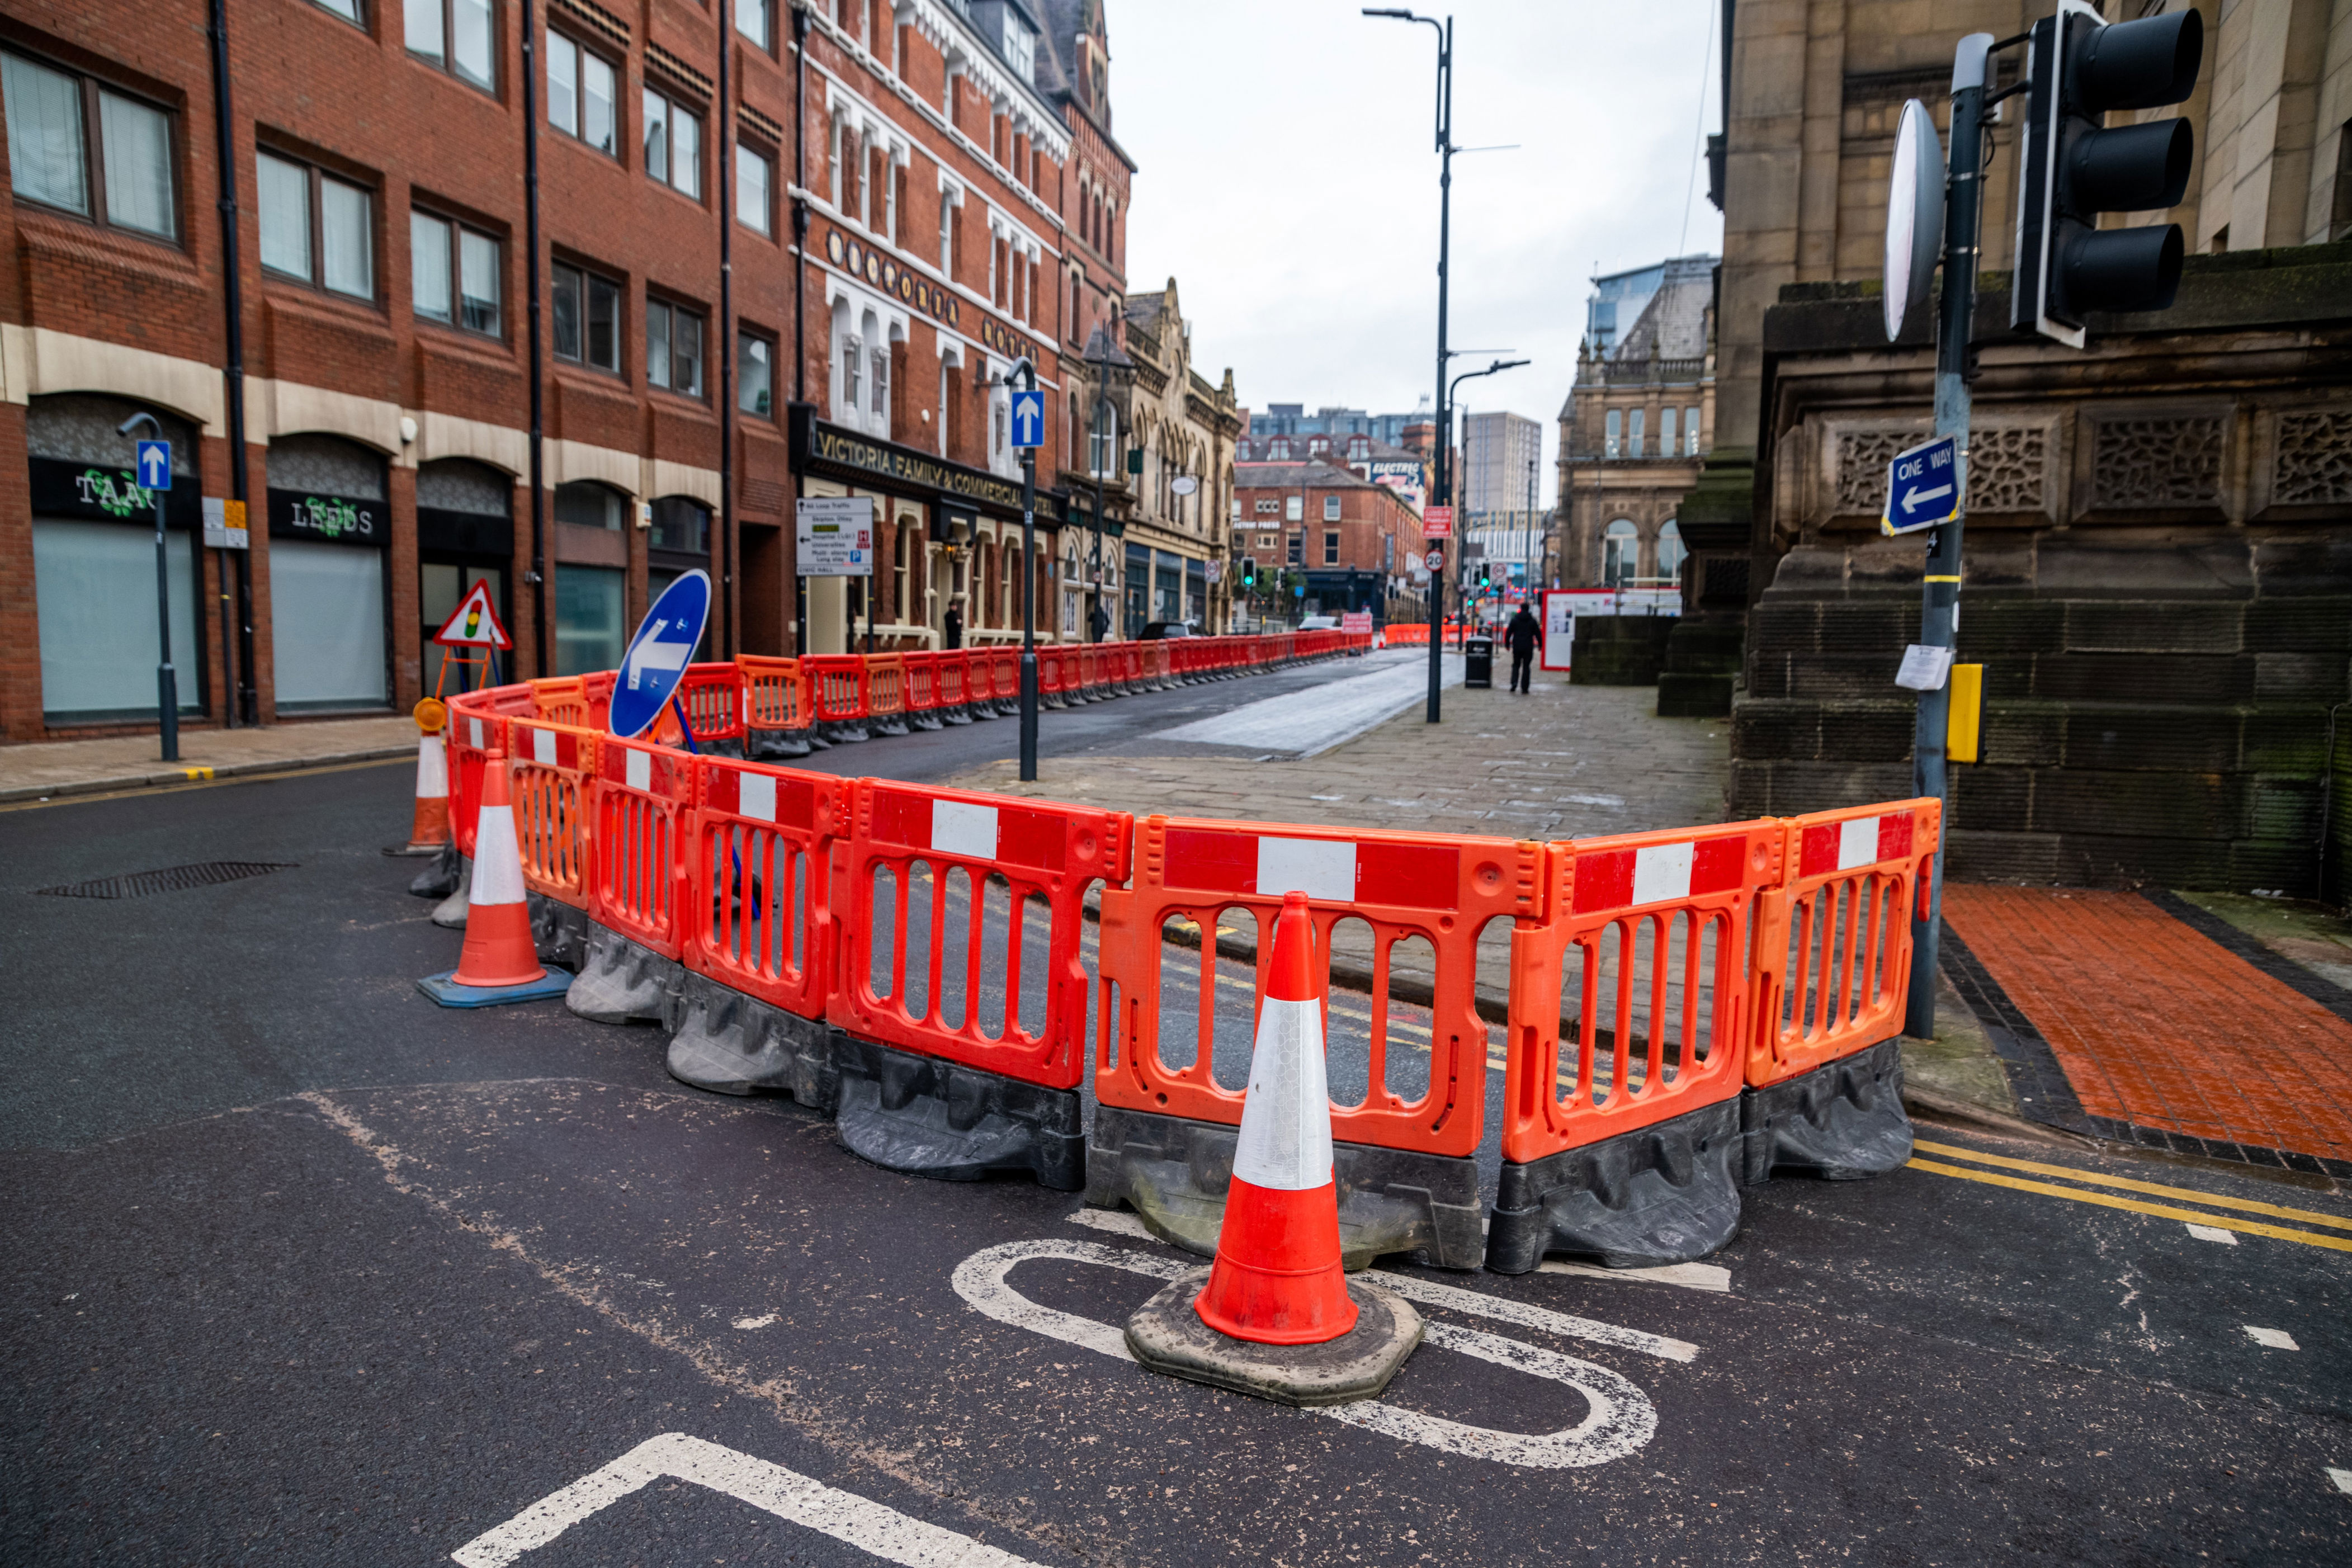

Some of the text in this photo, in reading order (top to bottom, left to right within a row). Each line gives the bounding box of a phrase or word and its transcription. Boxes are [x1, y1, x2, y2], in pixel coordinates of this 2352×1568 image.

[832, 232, 957, 323] VICTORIA
[818, 431, 1057, 518] VICTORIA FAMILY & COMMERCIAL OTEL
[1372, 462, 1420, 474] ELECTRIC
[1898, 446, 1952, 480] ONE WAY
[75, 475, 157, 510] TAA
[291, 503, 373, 535] LEEDS
[1258, 521, 1281, 530] PRESS
[1427, 556, 1442, 565] 20
